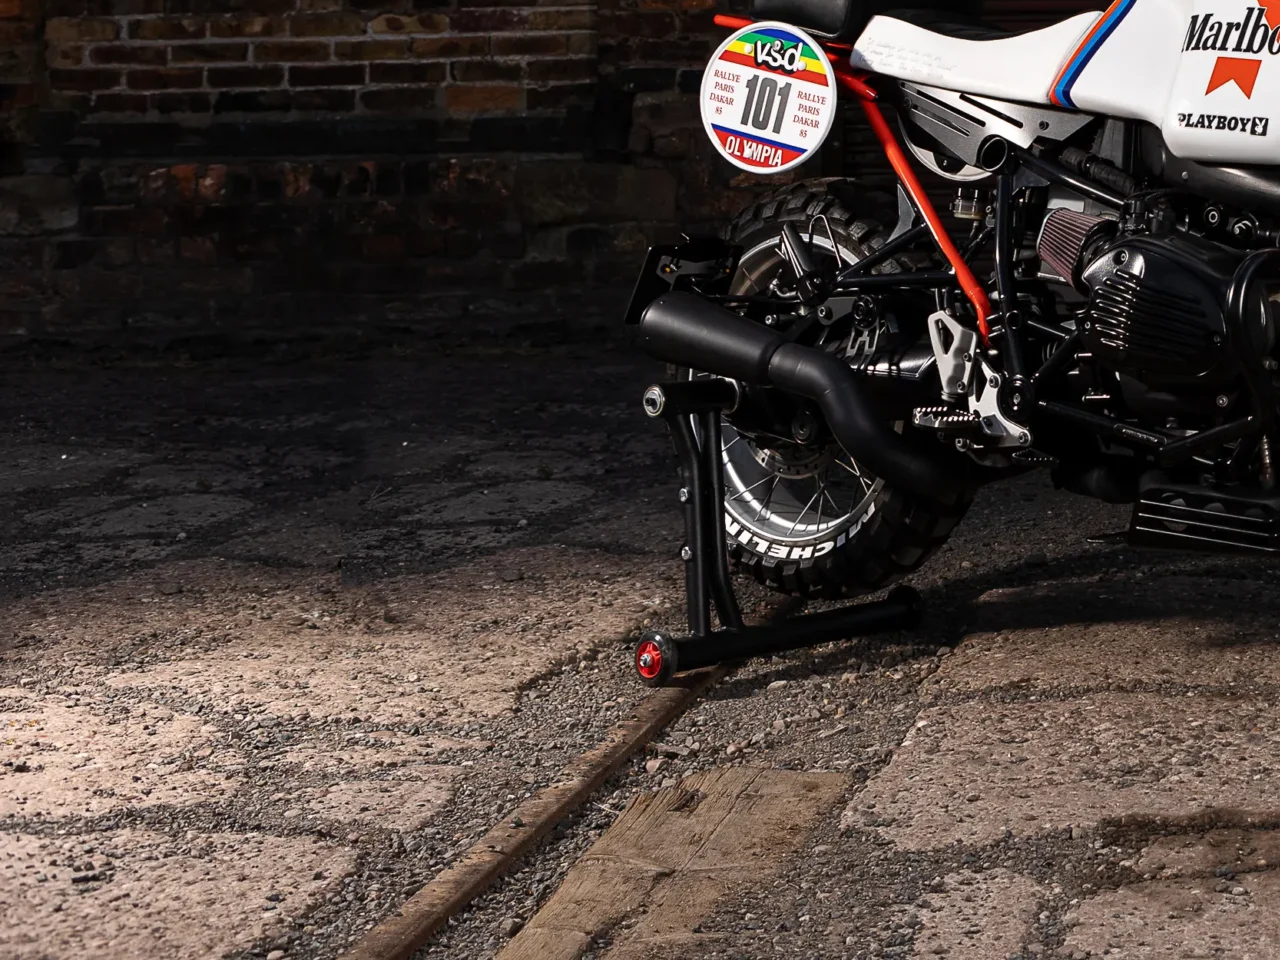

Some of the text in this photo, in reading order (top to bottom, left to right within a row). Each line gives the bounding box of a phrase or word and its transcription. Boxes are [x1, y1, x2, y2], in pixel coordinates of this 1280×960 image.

[713, 69, 741, 83] RALLYE
[714, 81, 735, 94] PARIS
[709, 92, 735, 106] DAKAR
[740, 74, 792, 134] 101
[797, 90, 827, 106] RALLYE
[714, 106, 723, 115] 85
[797, 103, 821, 116] PARIS
[792, 114, 820, 129] DAKAR
[1176, 112, 1251, 133] PLAYBOY
[798, 129, 808, 139] 85
[725, 135, 783, 167] OLYMPIA
